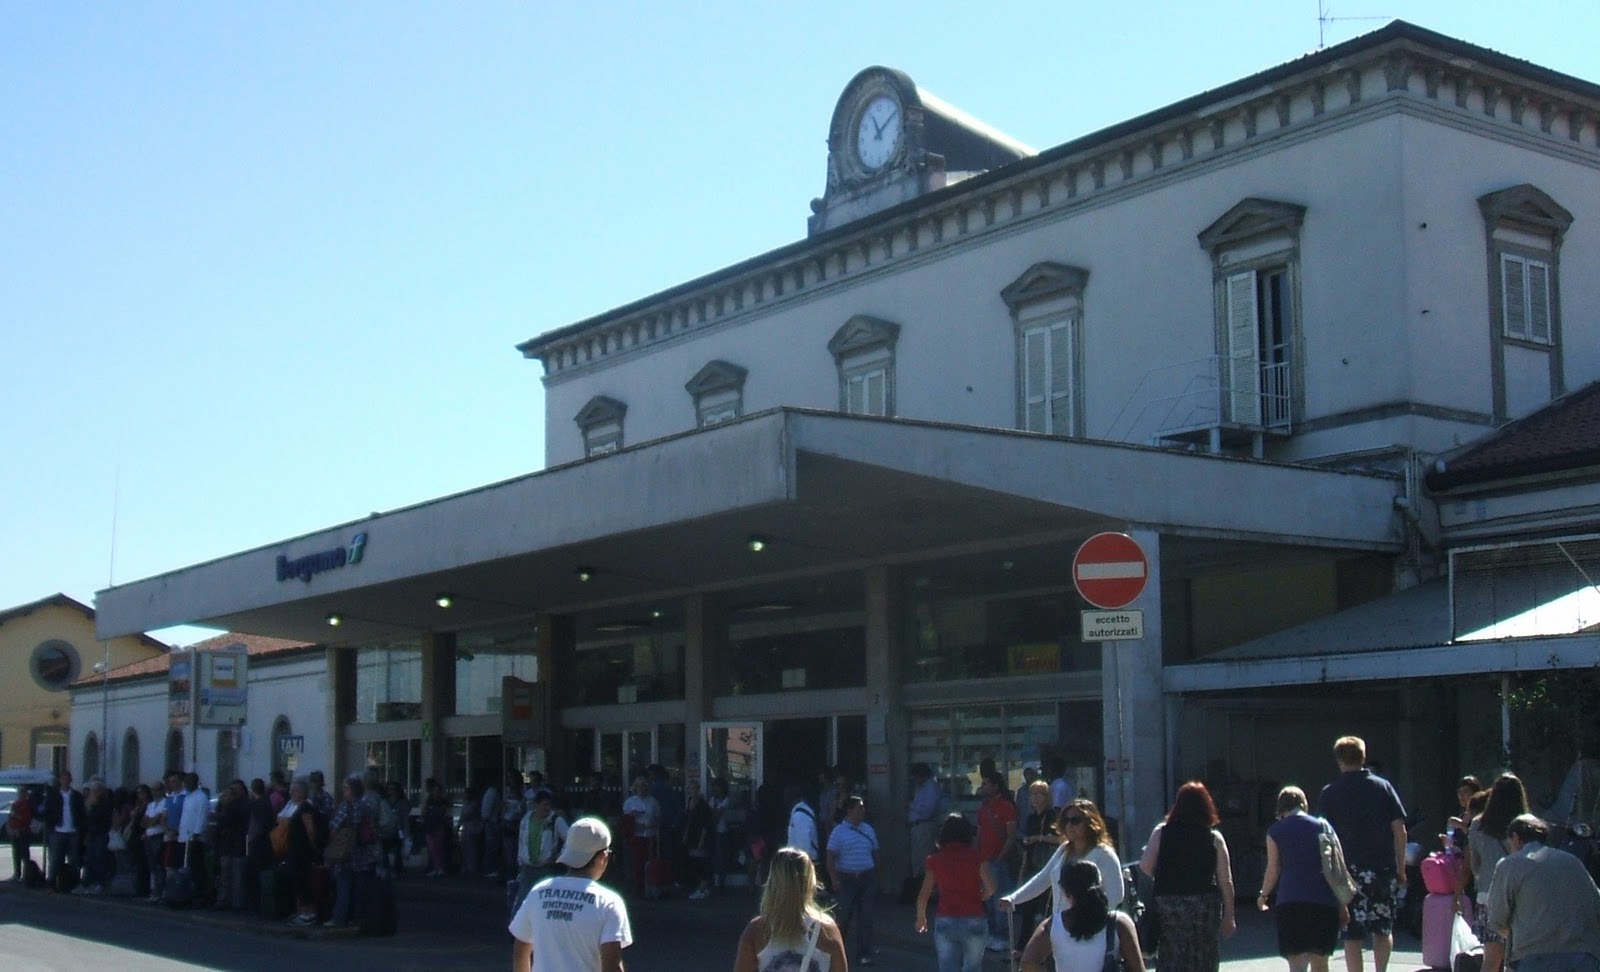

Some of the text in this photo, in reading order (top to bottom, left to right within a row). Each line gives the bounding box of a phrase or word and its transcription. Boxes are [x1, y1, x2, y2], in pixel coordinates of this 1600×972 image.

[1095, 615, 1130, 624] eccetto
[1088, 627, 1138, 637] autorizzati
[280, 738, 303, 752] TAXI
[538, 888, 596, 904] TRAINING
[542, 901, 583, 912] UNIFORM
[546, 910, 573, 921] PUMA
